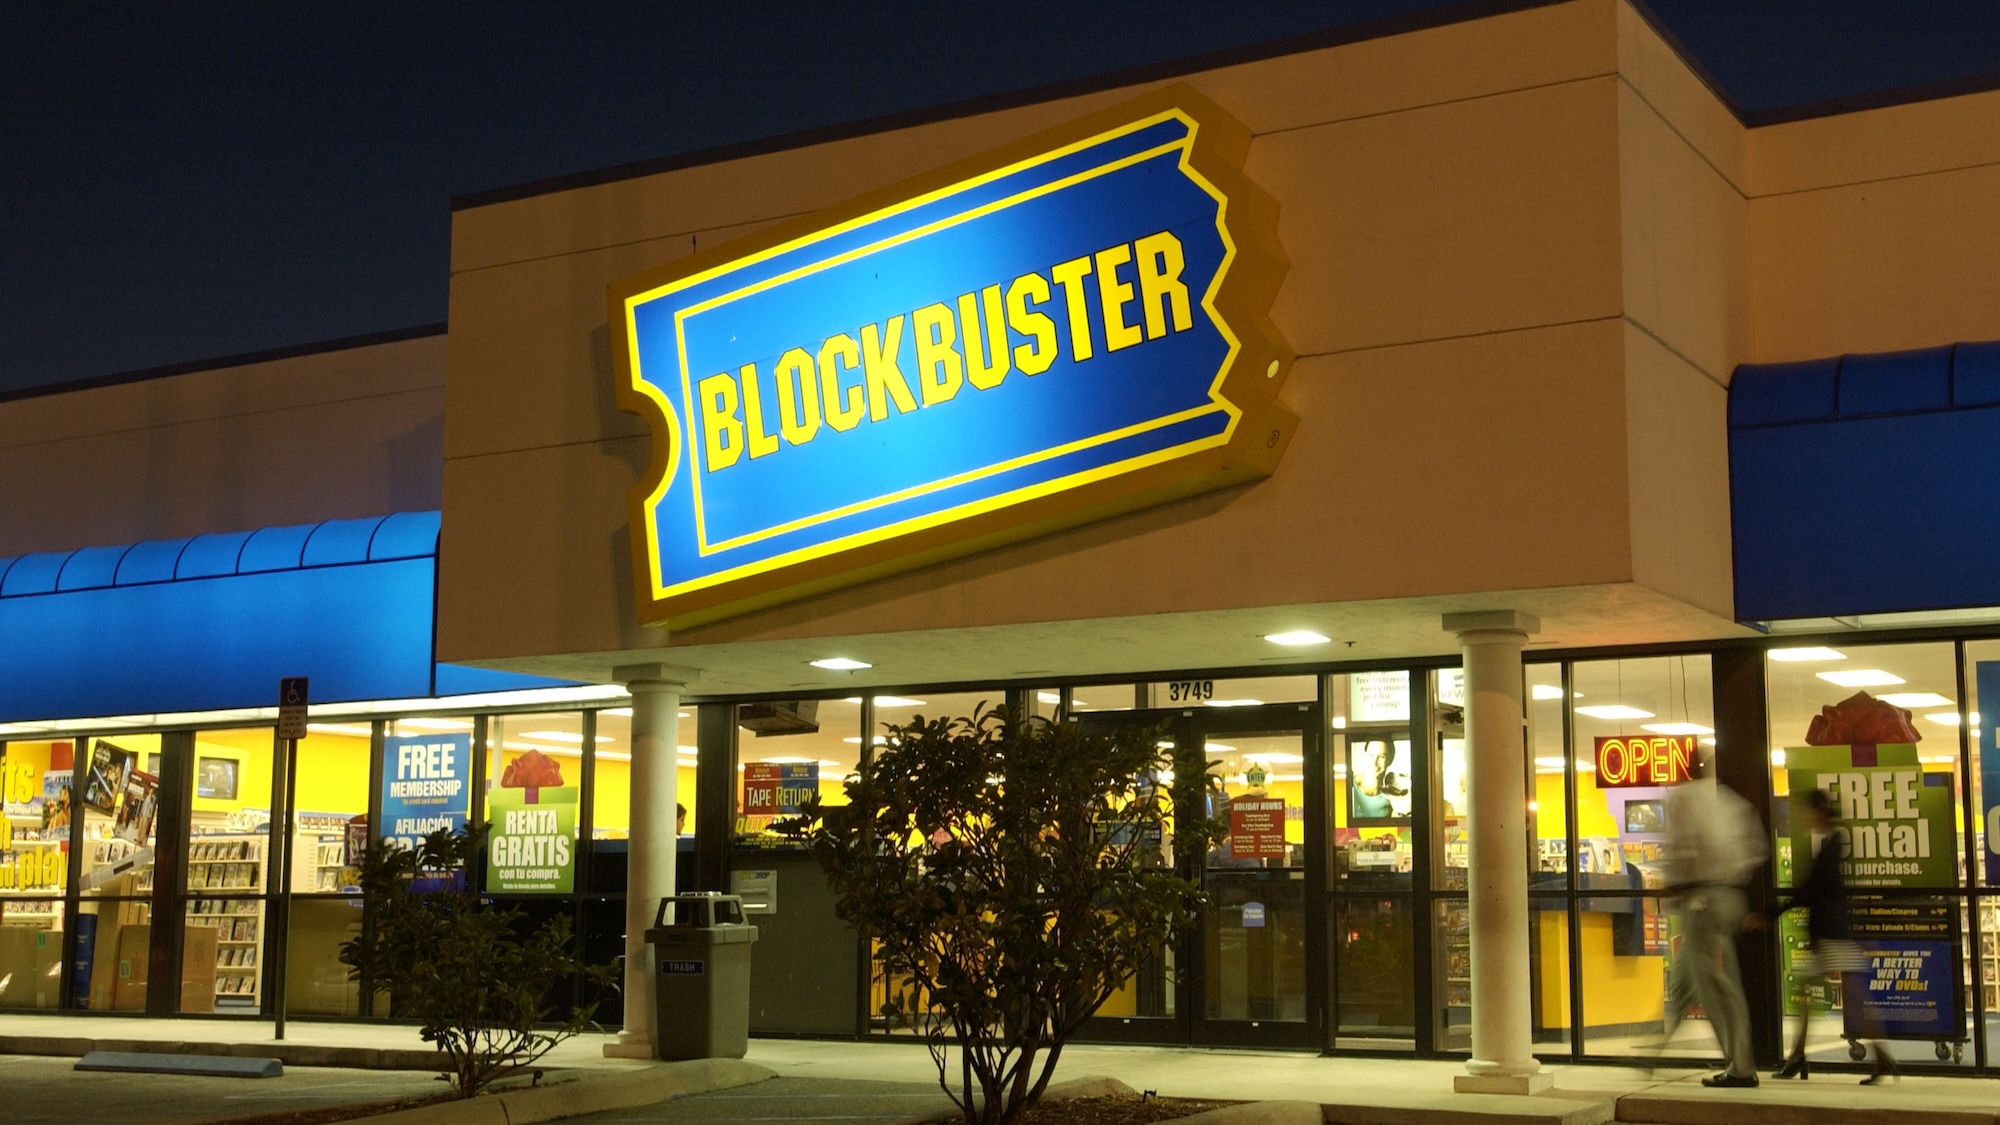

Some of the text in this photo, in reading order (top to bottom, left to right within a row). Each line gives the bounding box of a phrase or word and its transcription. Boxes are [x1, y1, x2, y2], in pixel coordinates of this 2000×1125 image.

[699, 230, 1194, 474] BLOCKBUSTER
[1170, 681, 1213, 701] 3749
[398, 743, 455, 779] FREE
[1600, 736, 1693, 784] OPEN
[390, 780, 461, 798] MEMBERSHIP
[747, 787, 771, 807] TAPE
[1816, 771, 1920, 819] FREE
[1233, 801, 1283, 812] HOLIDAY HOURS
[394, 815, 453, 835] AFILIACIÓN
[505, 809, 558, 835] RENTA
[492, 834, 570, 867] GRATIS
[499, 867, 561, 881] con tu compra.
[1855, 860, 1923, 877] purchase.
[669, 962, 696, 972] TRASH
[1872, 957, 1923, 968] A BETTER
[1876, 968, 1920, 979] WAY TO
[1869, 980, 1929, 991] BUY DVDs!
